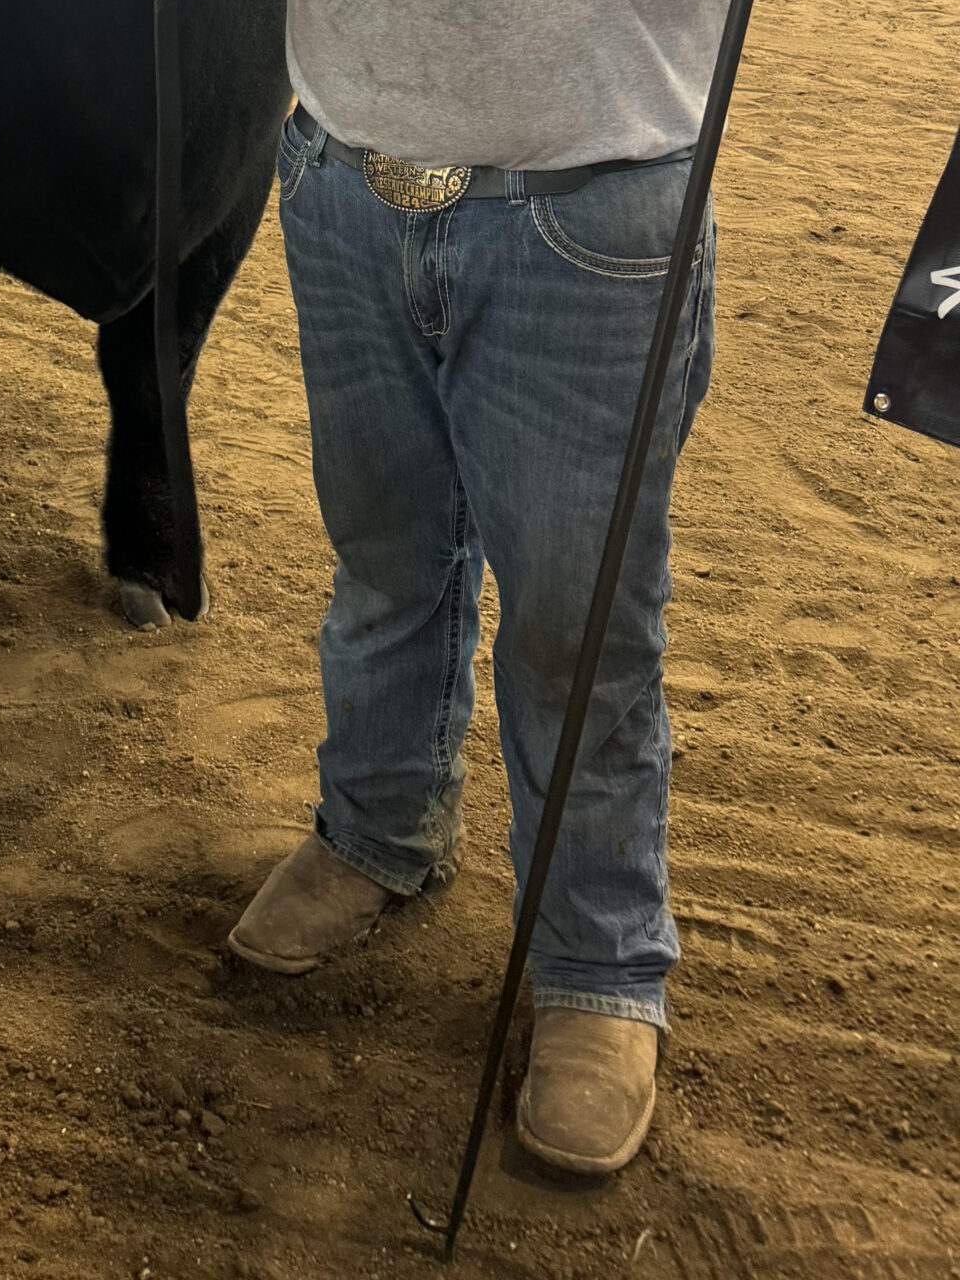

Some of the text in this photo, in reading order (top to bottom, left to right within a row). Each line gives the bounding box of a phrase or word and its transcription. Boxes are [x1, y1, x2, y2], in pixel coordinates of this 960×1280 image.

[374, 162, 417, 177] WESTERN
[374, 176, 445, 202] RESERVE CHAMPION
